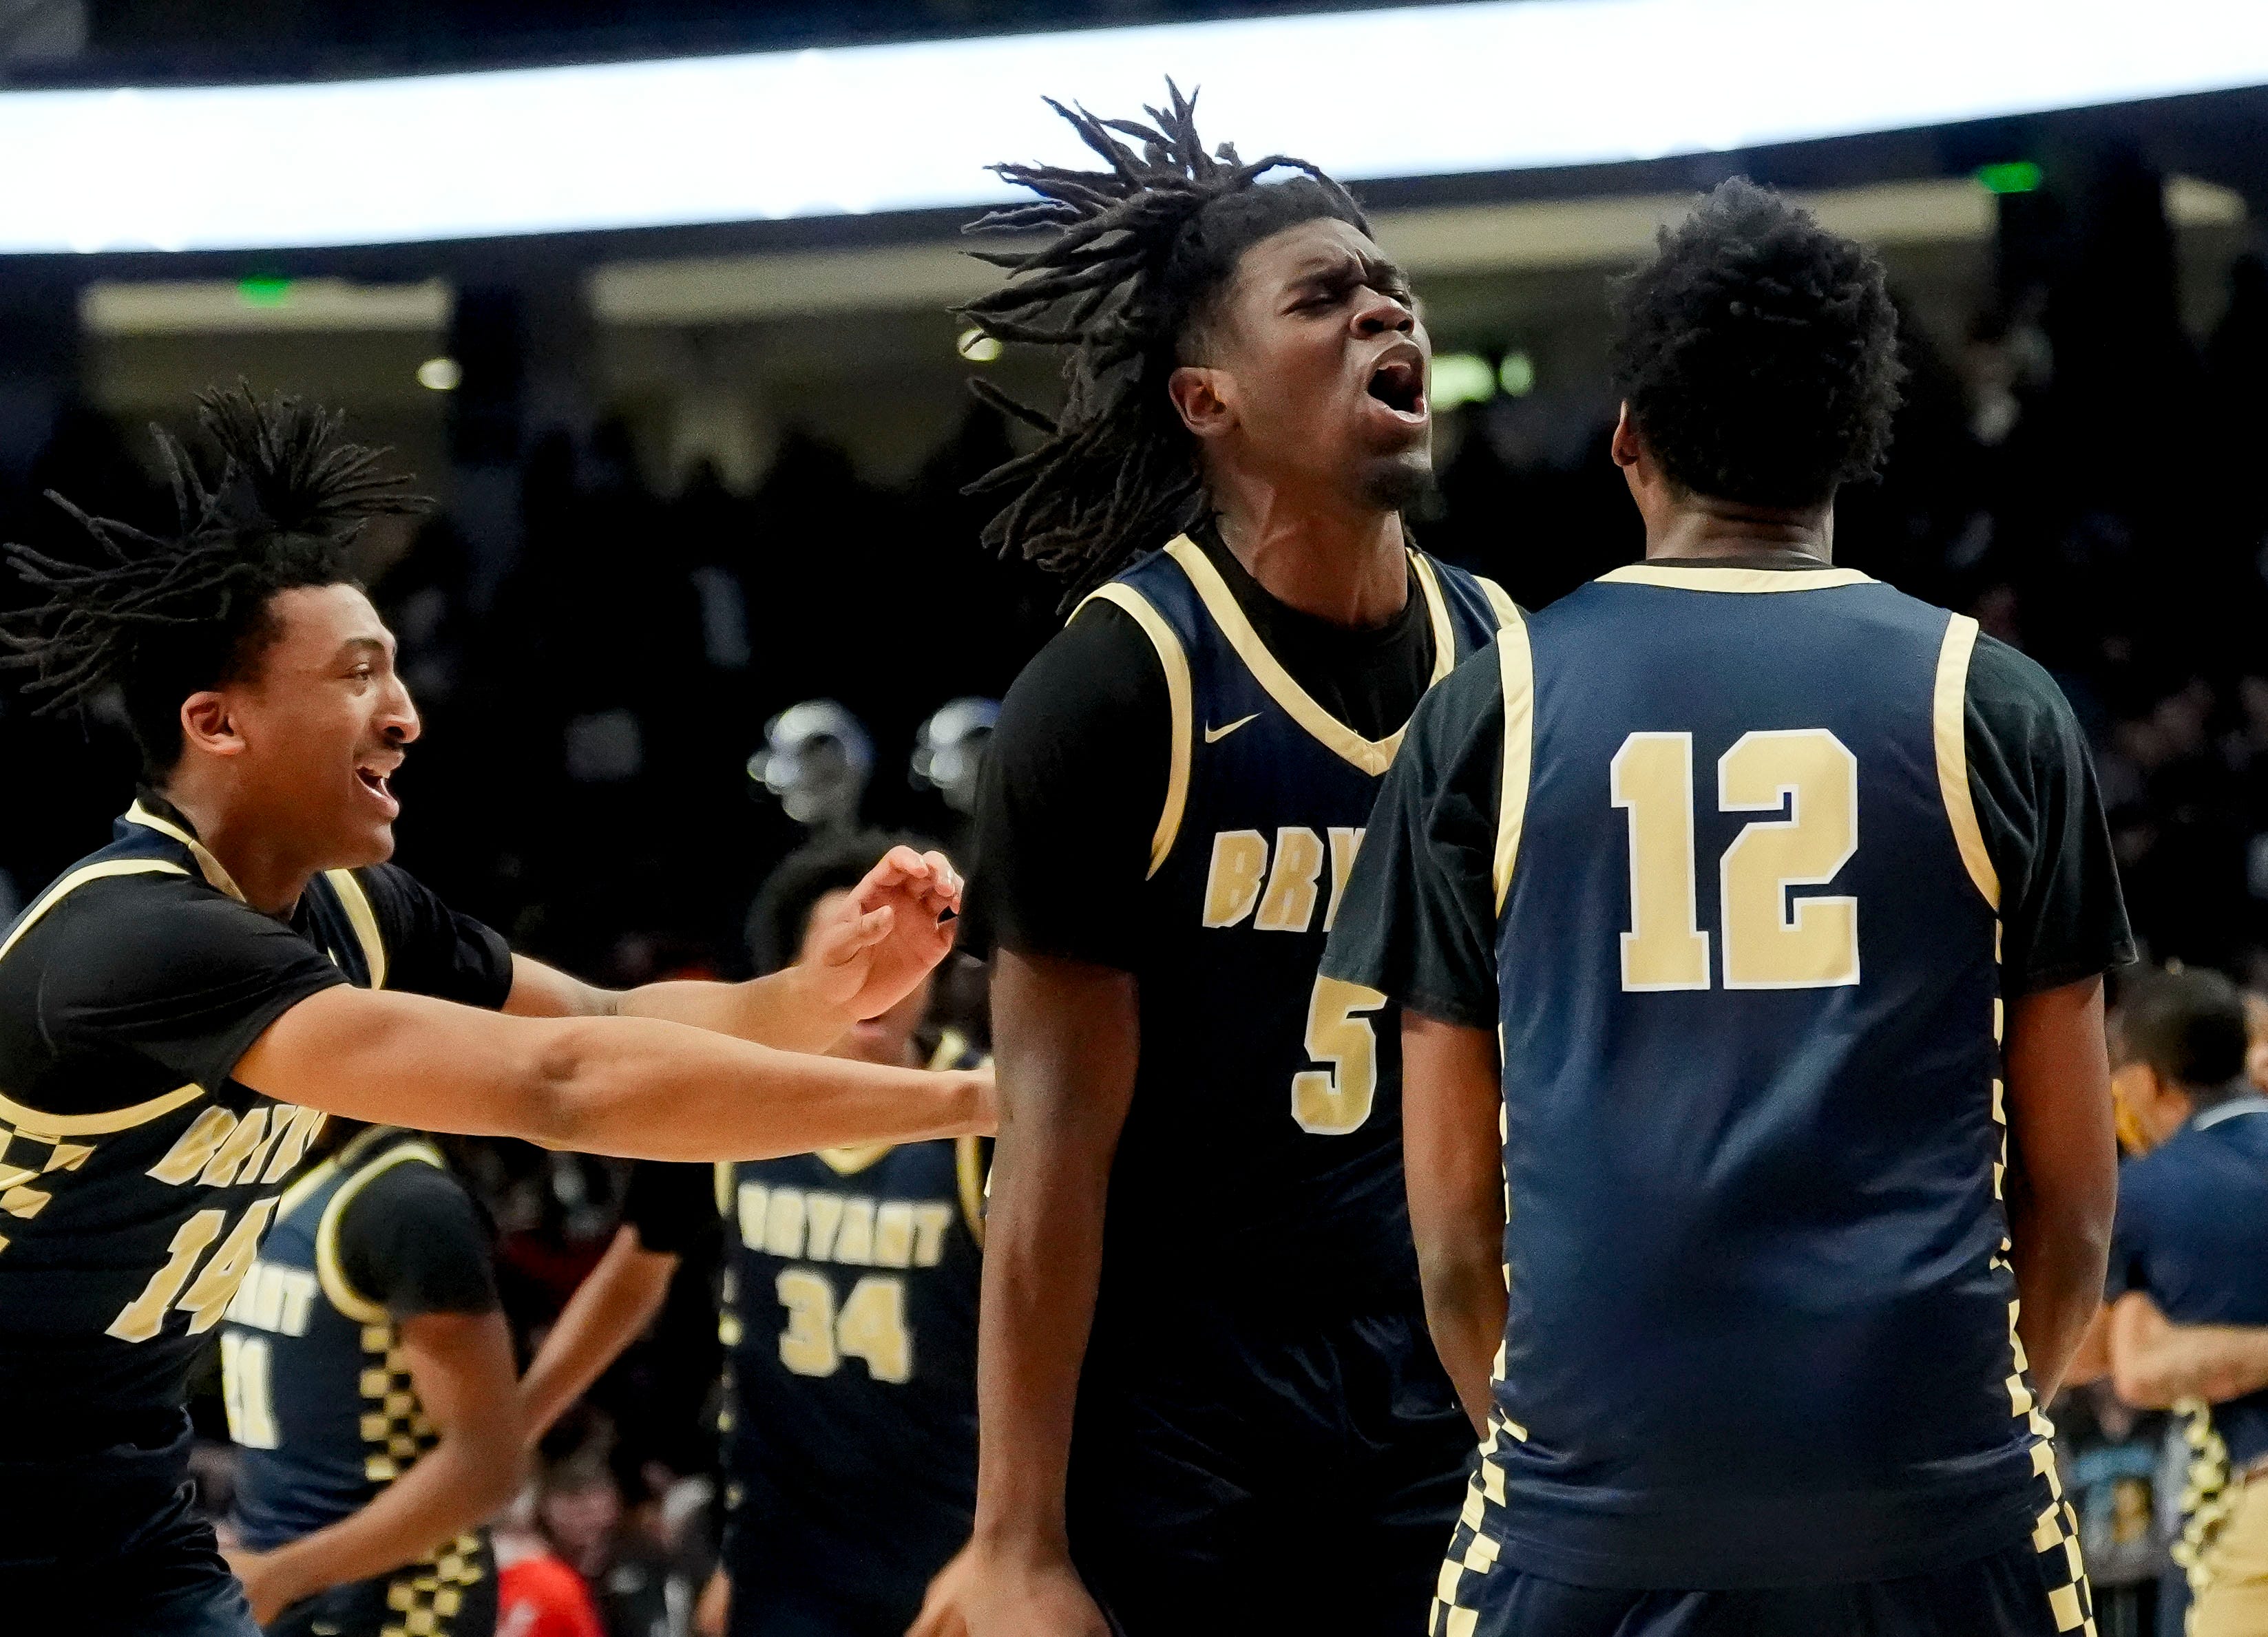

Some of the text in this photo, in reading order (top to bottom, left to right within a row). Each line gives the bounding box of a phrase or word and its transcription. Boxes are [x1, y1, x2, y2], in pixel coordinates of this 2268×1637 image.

[1610, 728, 1860, 992] 12
[1291, 973, 1389, 1135] 5
[104, 1195, 281, 1343] 14
[737, 1181, 954, 1269] BRYANT
[775, 1267, 912, 1385] 34
